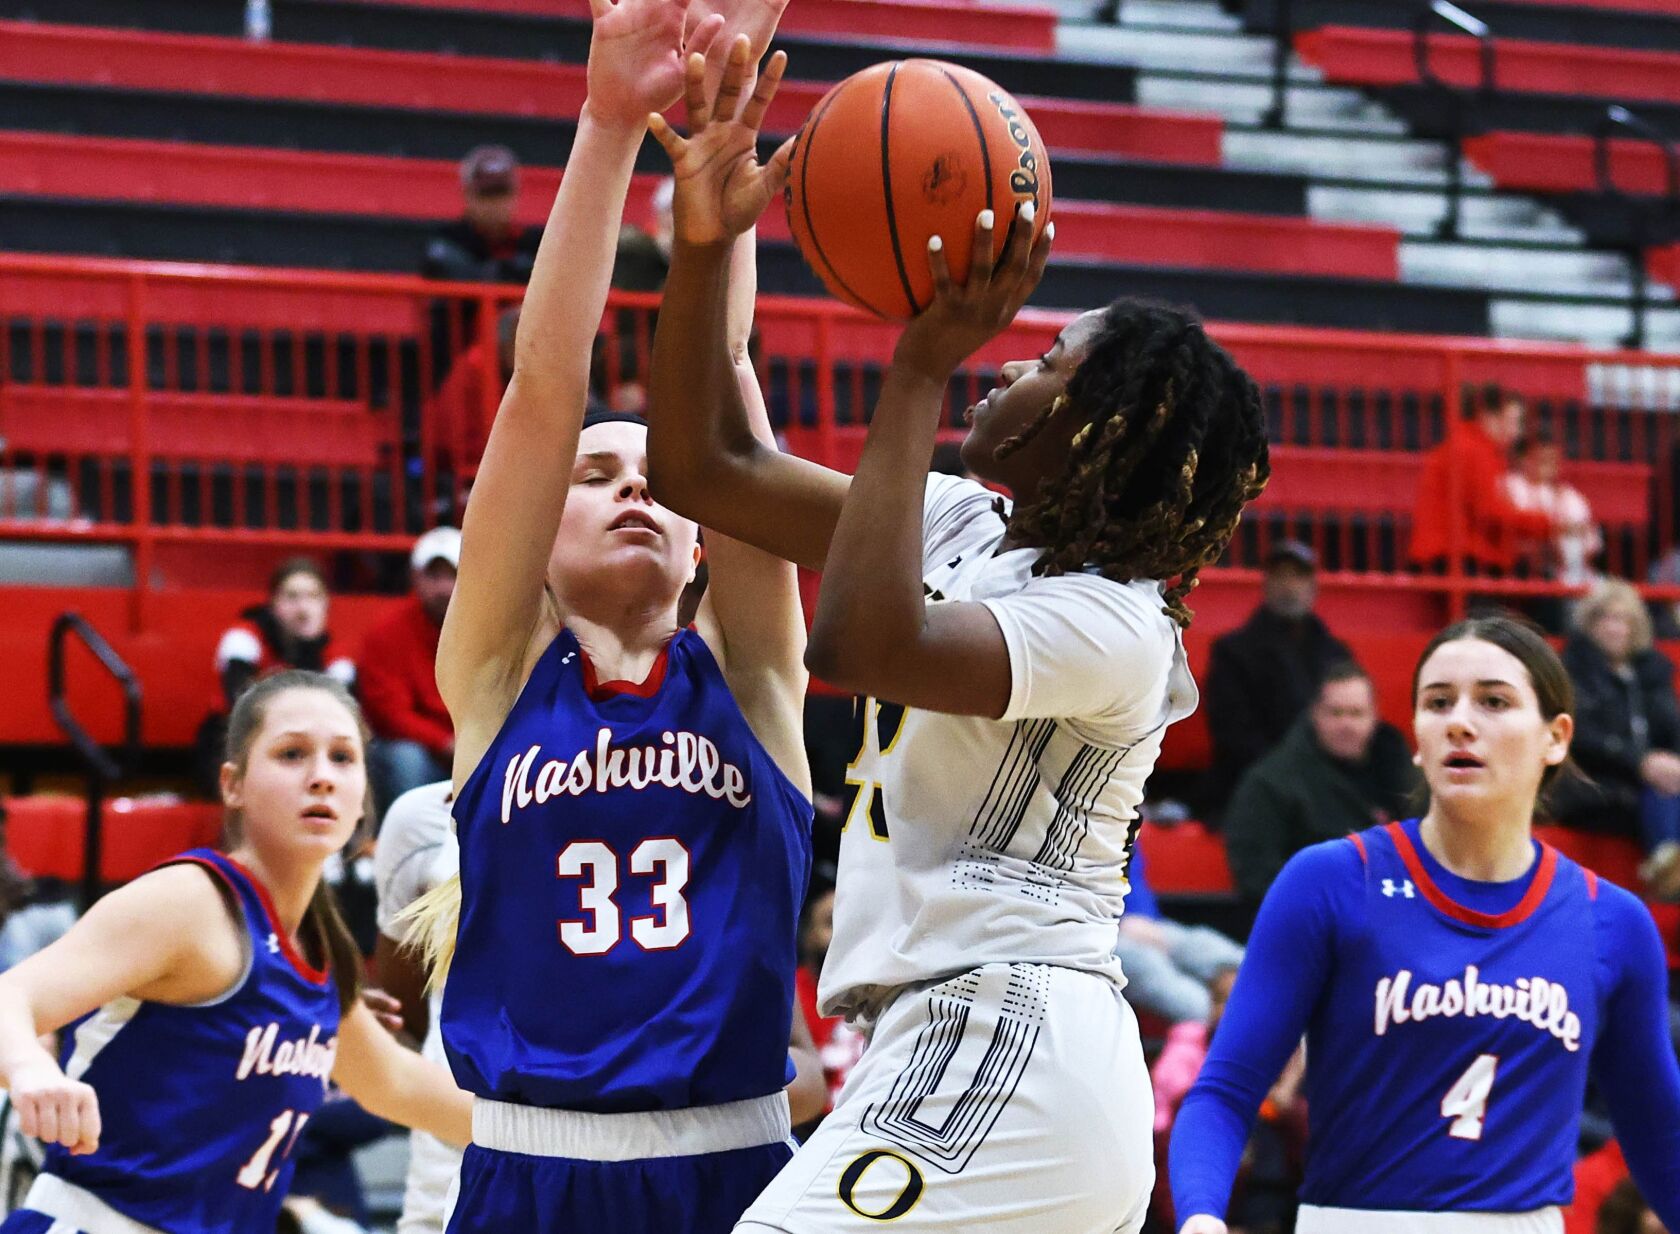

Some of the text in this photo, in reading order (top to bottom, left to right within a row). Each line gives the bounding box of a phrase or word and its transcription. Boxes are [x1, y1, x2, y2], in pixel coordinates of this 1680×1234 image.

[987, 91, 1039, 214] lson
[501, 727, 751, 824] Nashville
[557, 836, 692, 956] 33
[1375, 964, 1581, 1052] Nashville
[1440, 1053, 1499, 1141] 4
[837, 1148, 926, 1223] O
